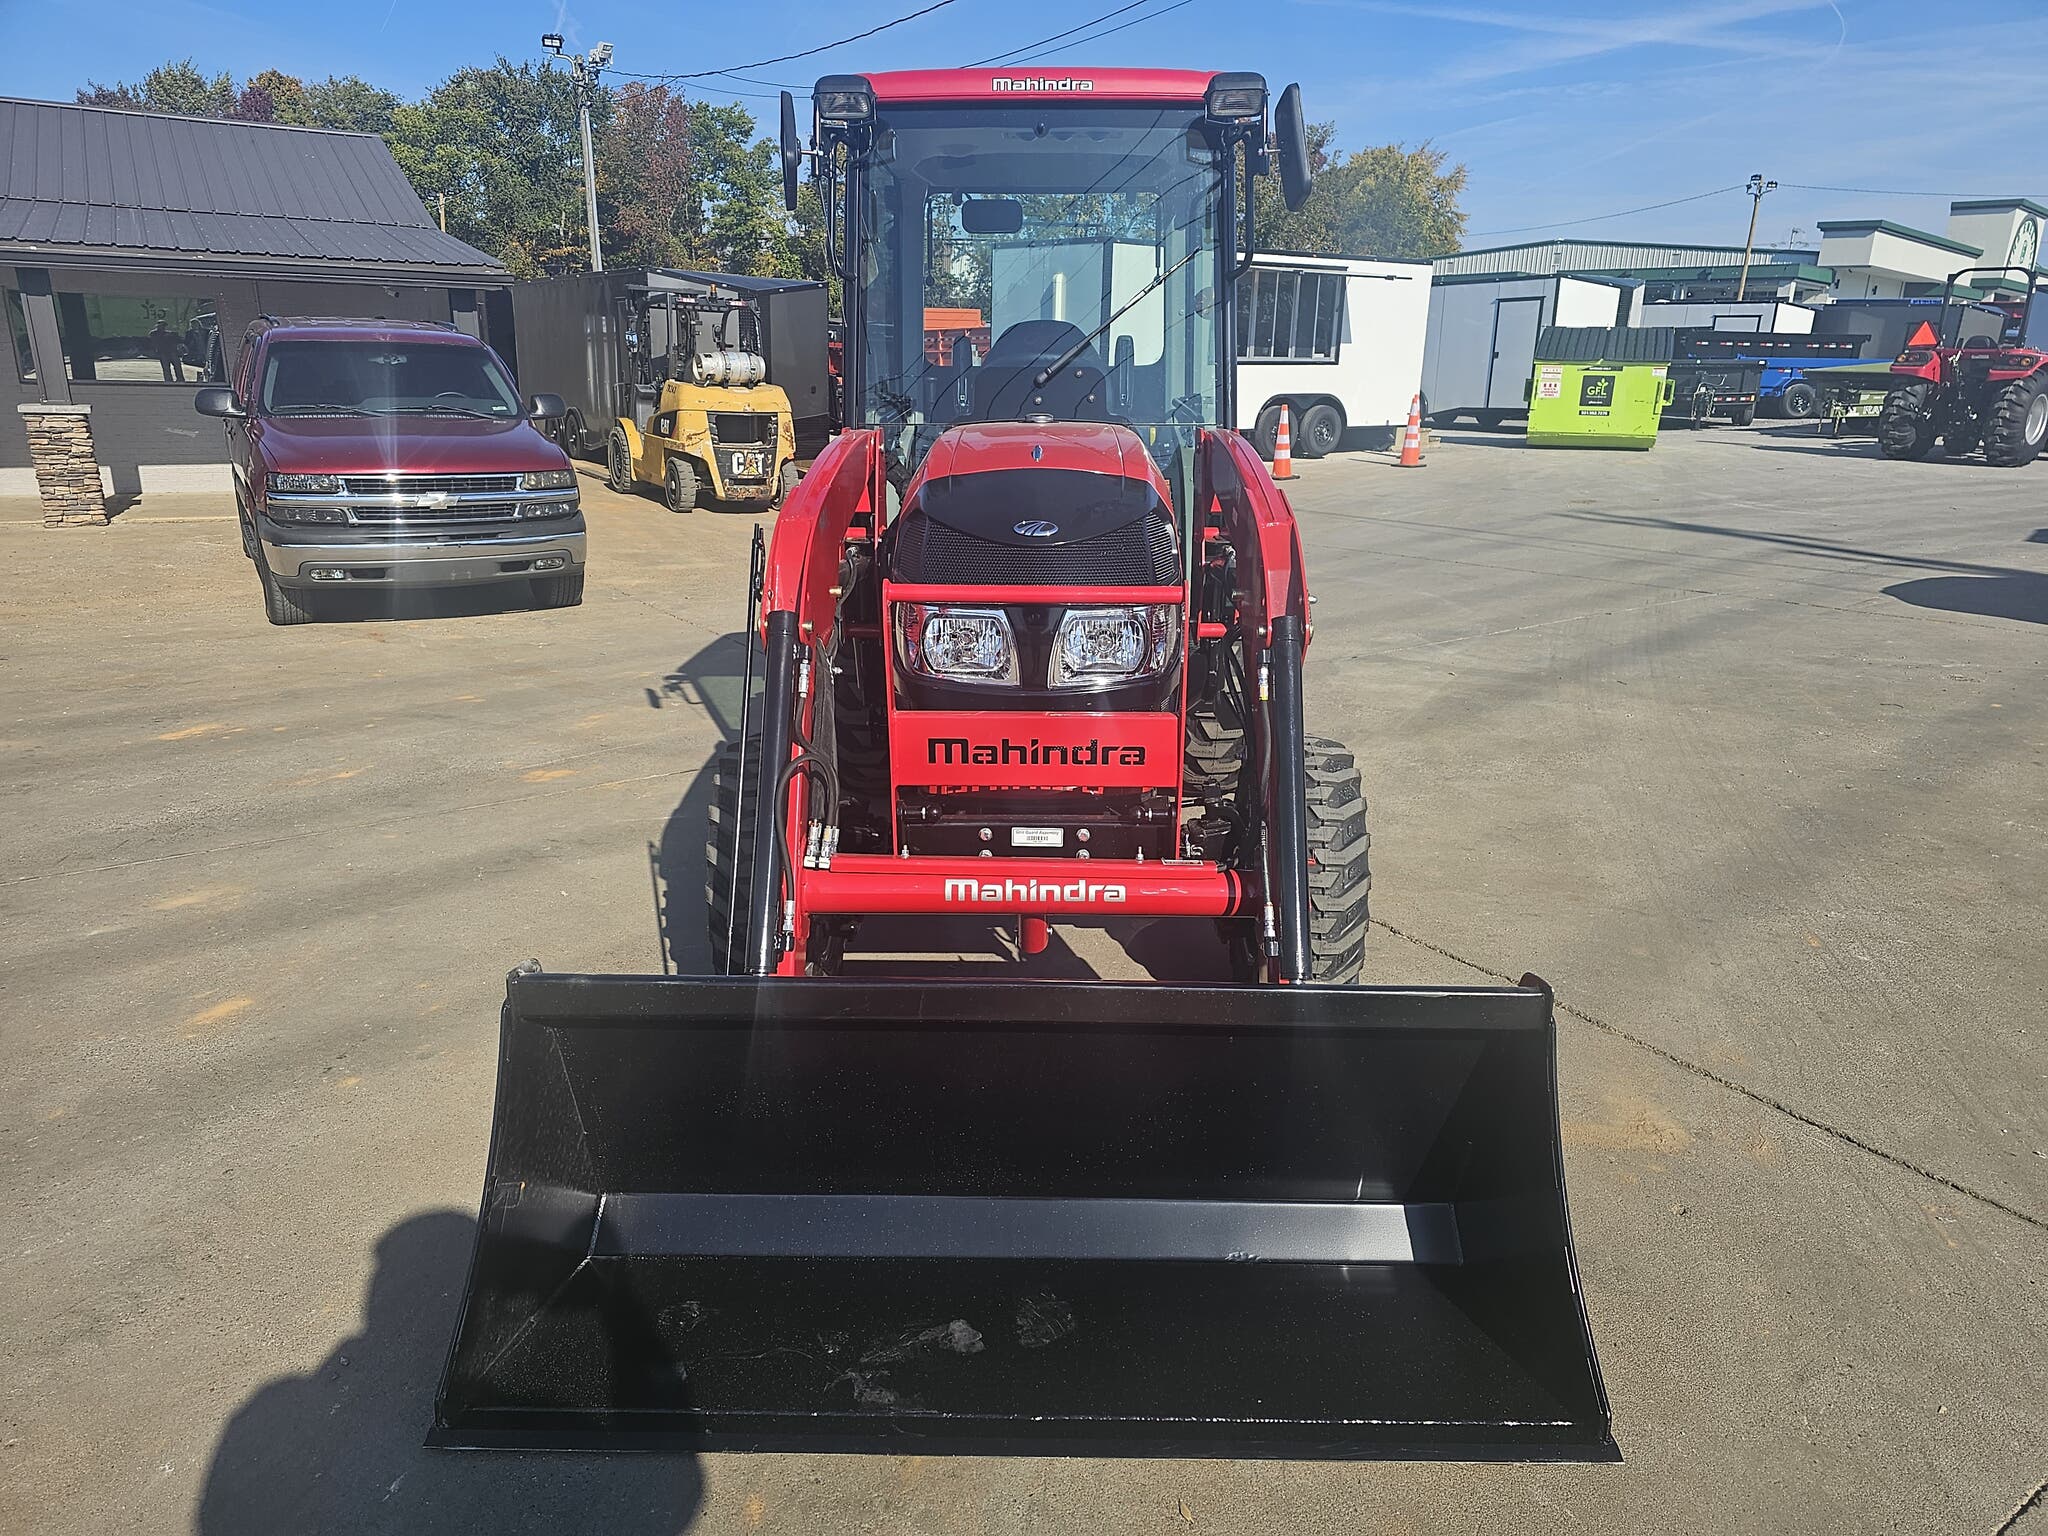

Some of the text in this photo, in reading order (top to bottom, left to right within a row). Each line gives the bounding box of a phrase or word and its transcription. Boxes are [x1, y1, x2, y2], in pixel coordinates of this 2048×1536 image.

[992, 77, 1094, 91] Mahindra
[1586, 385, 1607, 396] GFL
[731, 452, 765, 476] CAT
[928, 738, 1145, 766] Mahindra
[944, 879, 1126, 903] Mahindra
